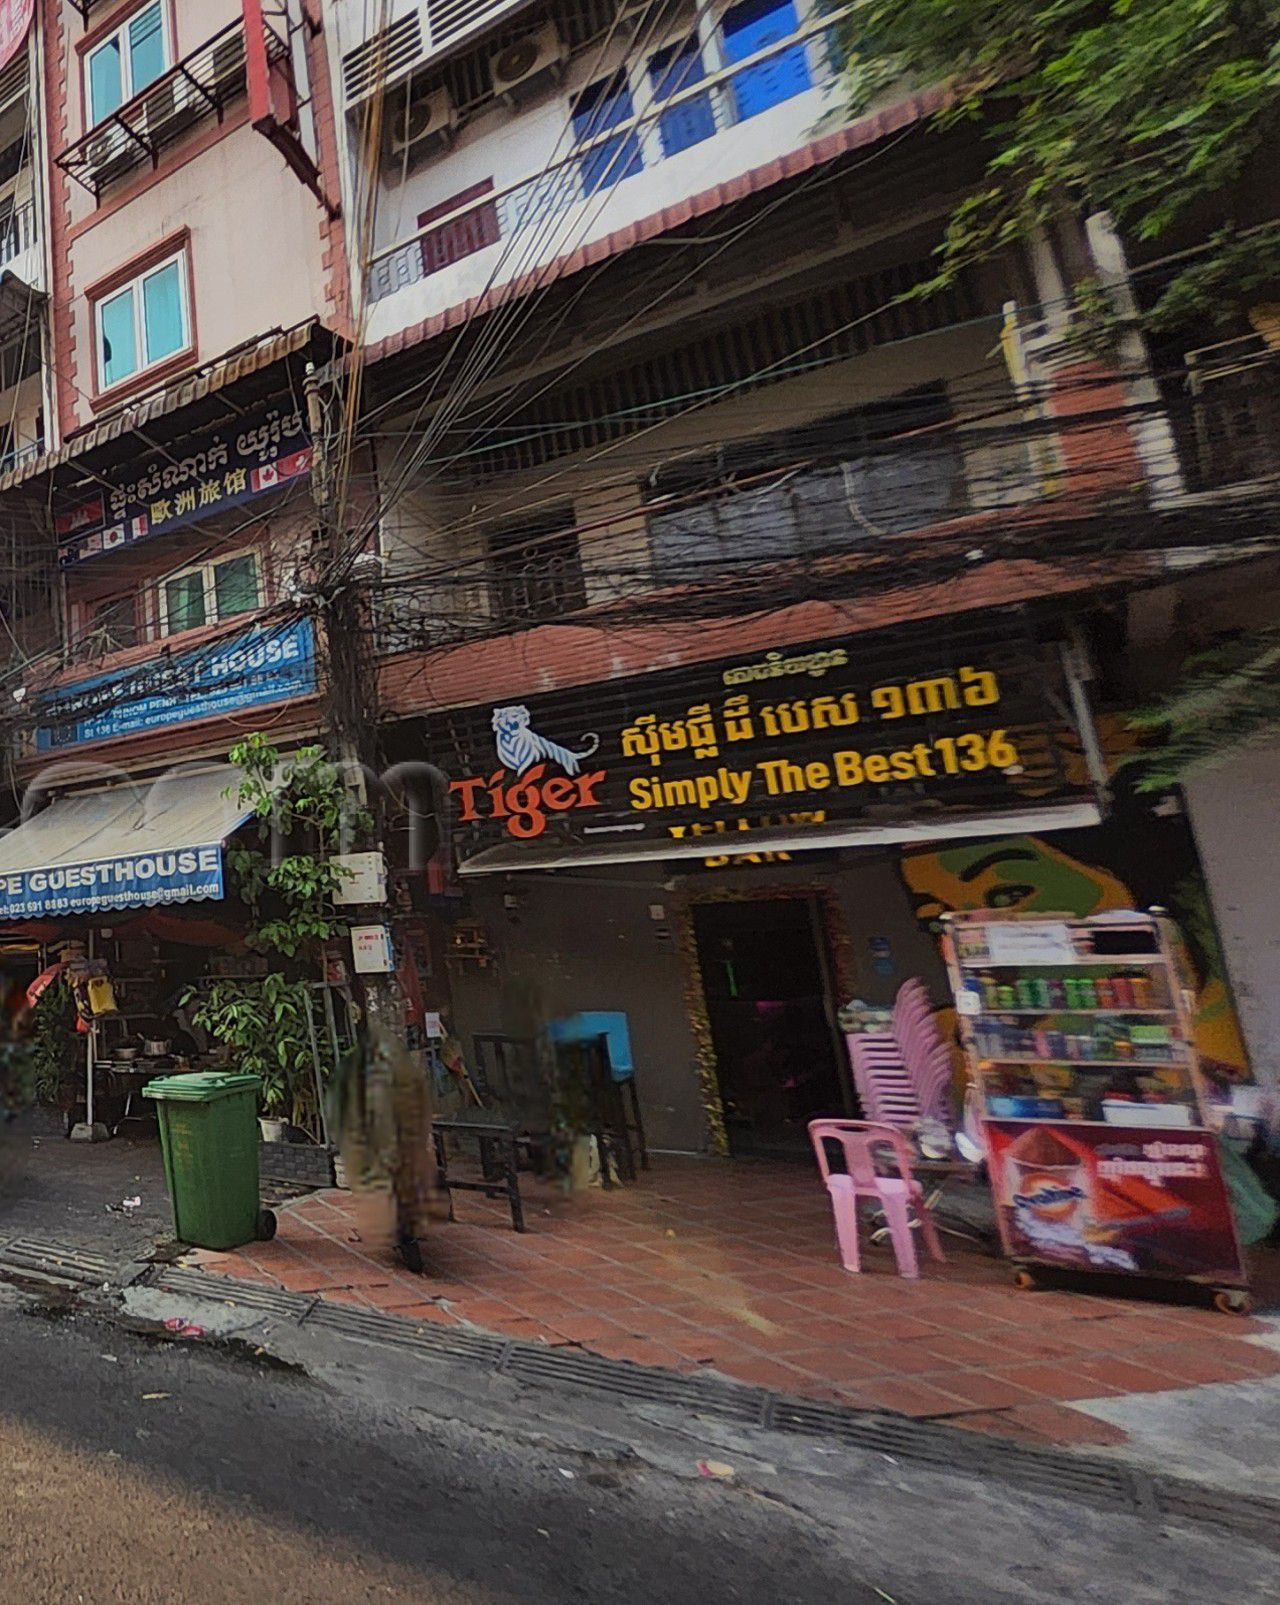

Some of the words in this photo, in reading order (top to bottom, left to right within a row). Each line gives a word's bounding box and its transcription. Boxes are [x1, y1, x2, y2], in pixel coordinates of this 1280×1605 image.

[871, 666, 1000, 719] ១៣៦
[448, 763, 608, 838] Tiger
[629, 767, 752, 810] Simply
[758, 759, 831, 796] The
[833, 743, 936, 787] Best
[934, 729, 1019, 775] 136
[29, 849, 219, 892] GUESTHOUSE
